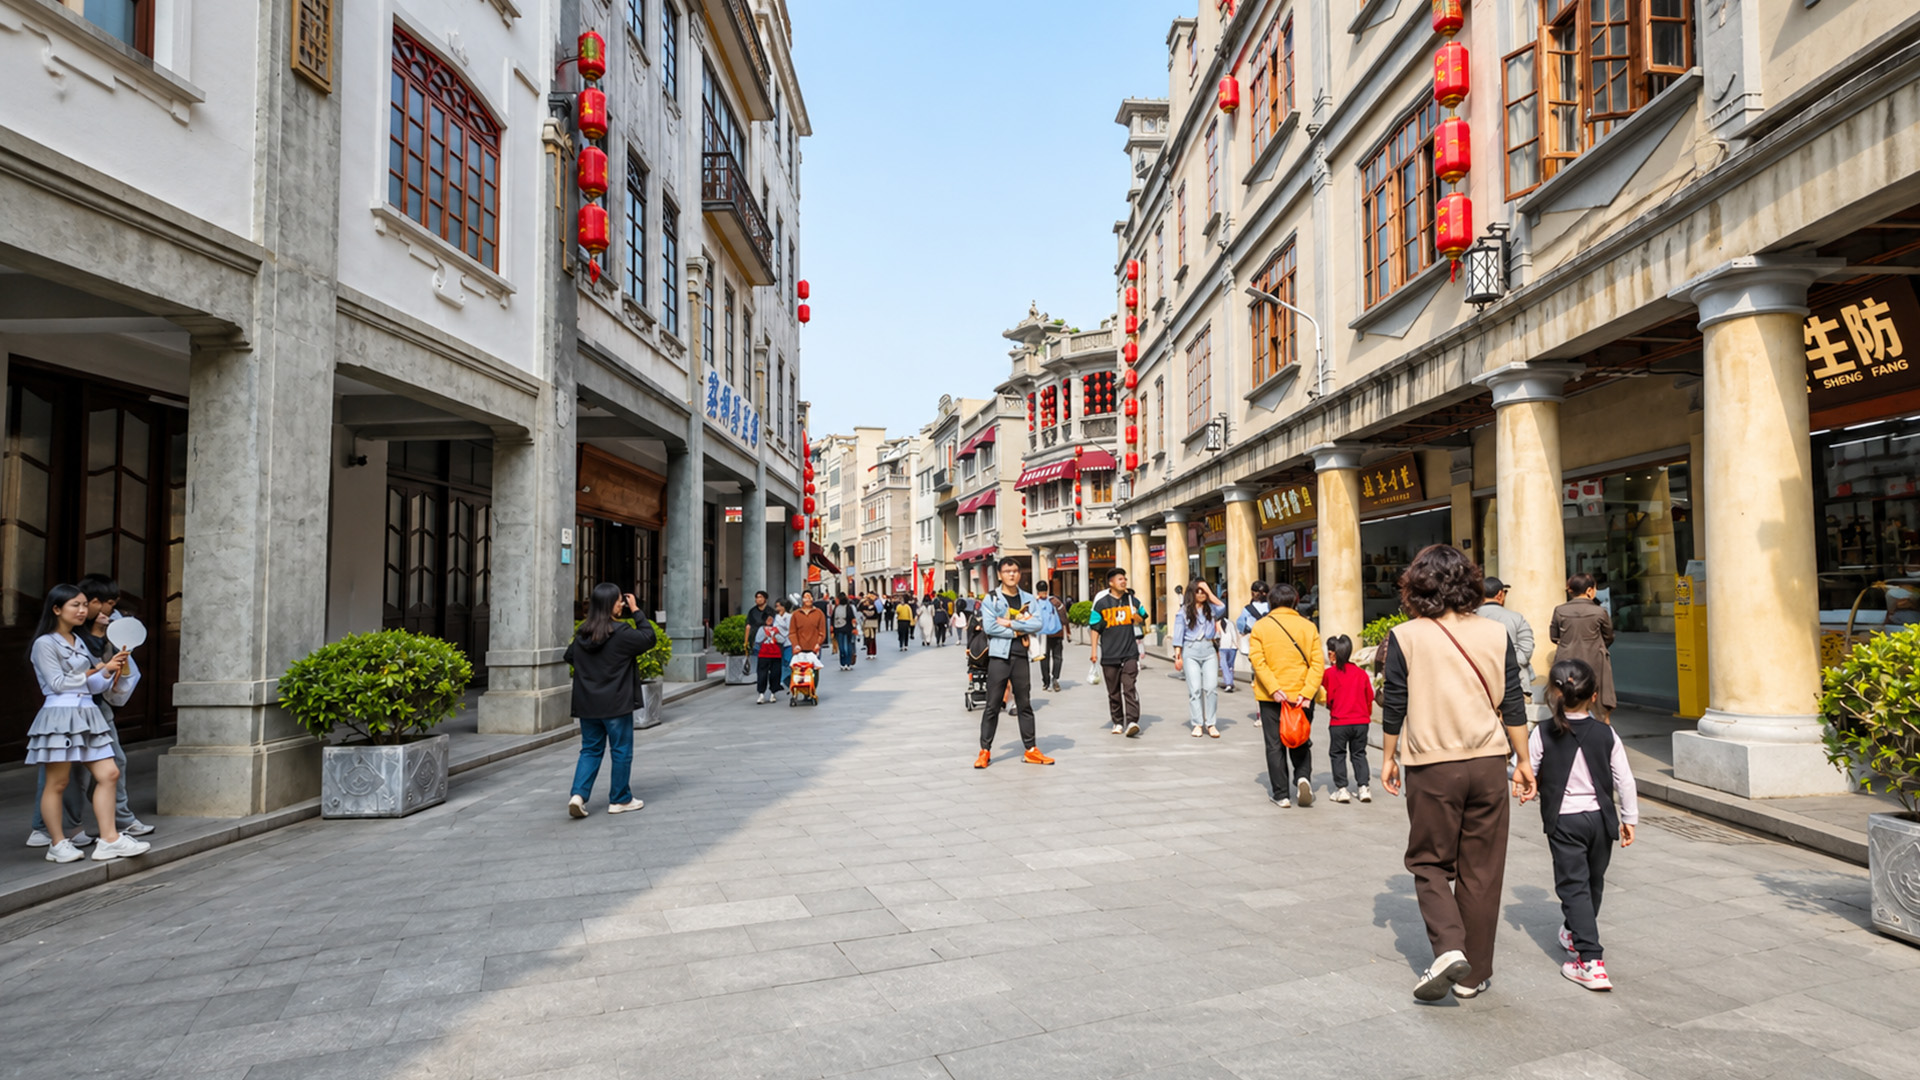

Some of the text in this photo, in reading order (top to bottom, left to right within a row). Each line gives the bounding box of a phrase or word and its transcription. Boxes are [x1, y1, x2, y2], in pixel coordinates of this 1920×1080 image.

[1804, 297, 1903, 380] 生防
[1823, 371, 1863, 389] SHENG
[1871, 359, 1909, 377] FANG
